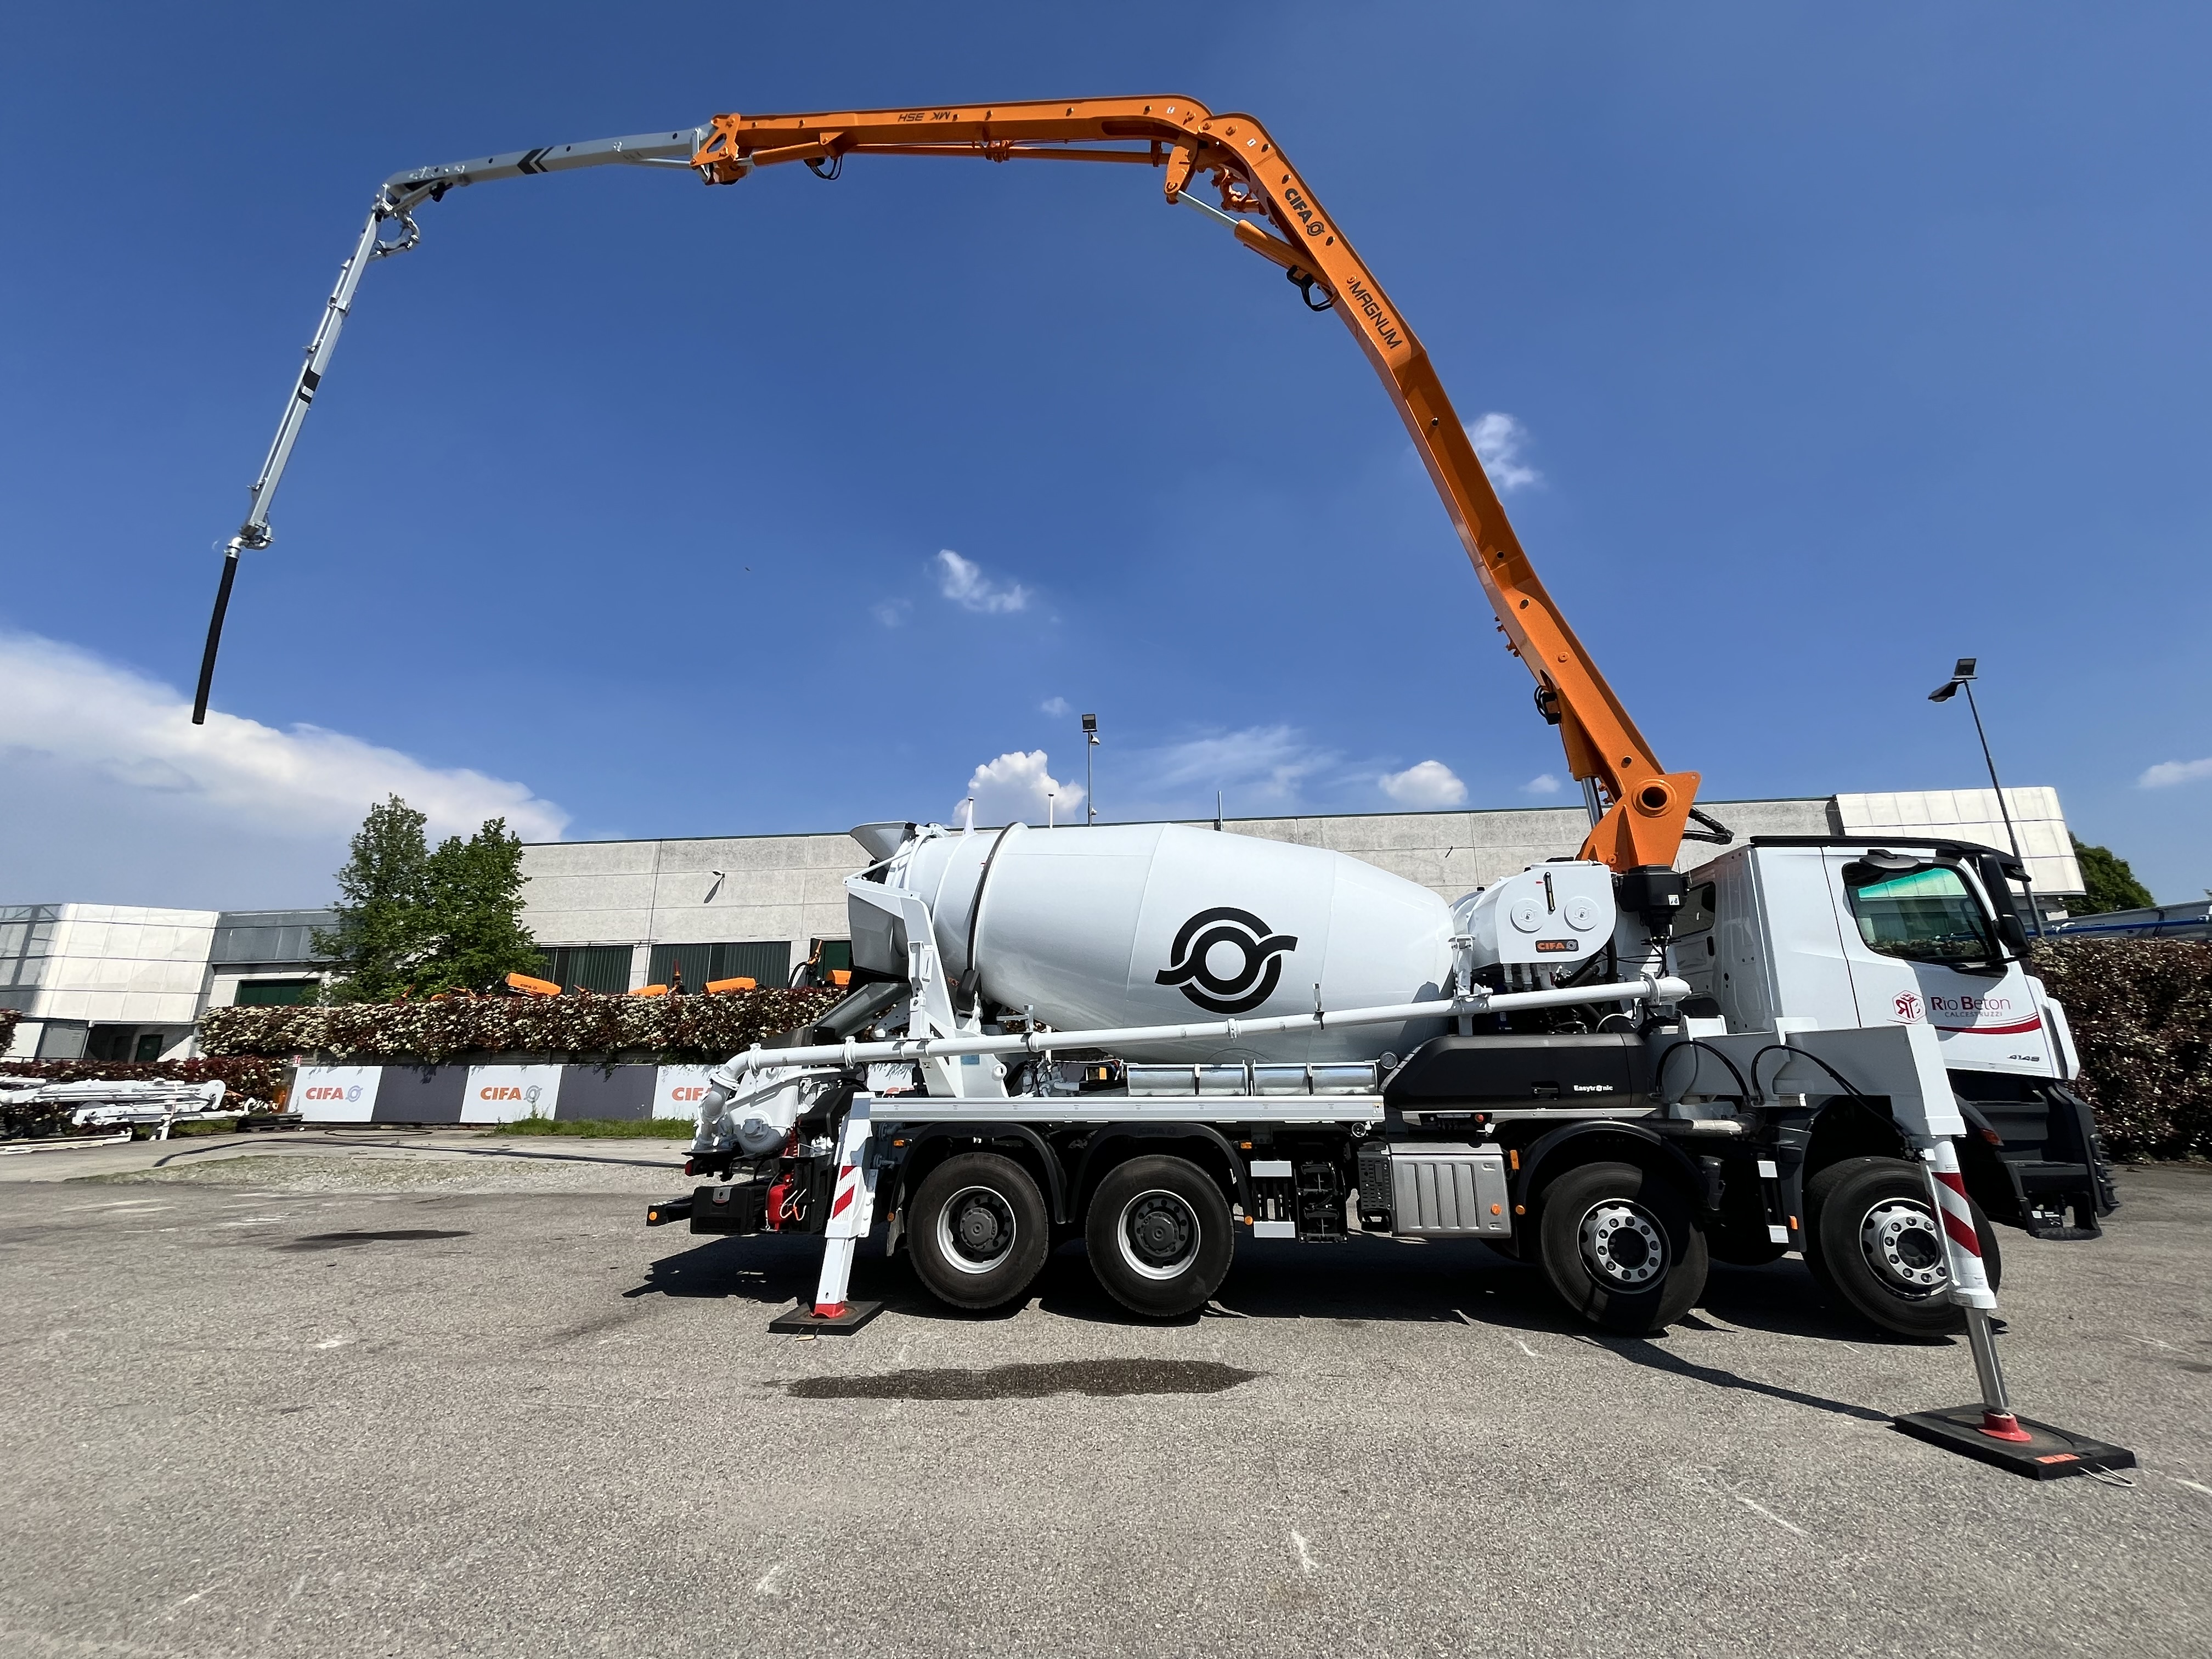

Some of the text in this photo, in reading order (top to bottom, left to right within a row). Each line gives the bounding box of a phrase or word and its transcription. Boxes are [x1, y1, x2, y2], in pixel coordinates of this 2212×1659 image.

[898, 111, 951, 122] MK 35H
[1285, 188, 1312, 224] CIFA
[1348, 281, 1403, 349] MAGNUM
[1930, 996, 2011, 1011] Rio Beton
[306, 1087, 343, 1100] CIFA
[481, 1087, 522, 1100] CIFA
[672, 1087, 712, 1101] CIF
